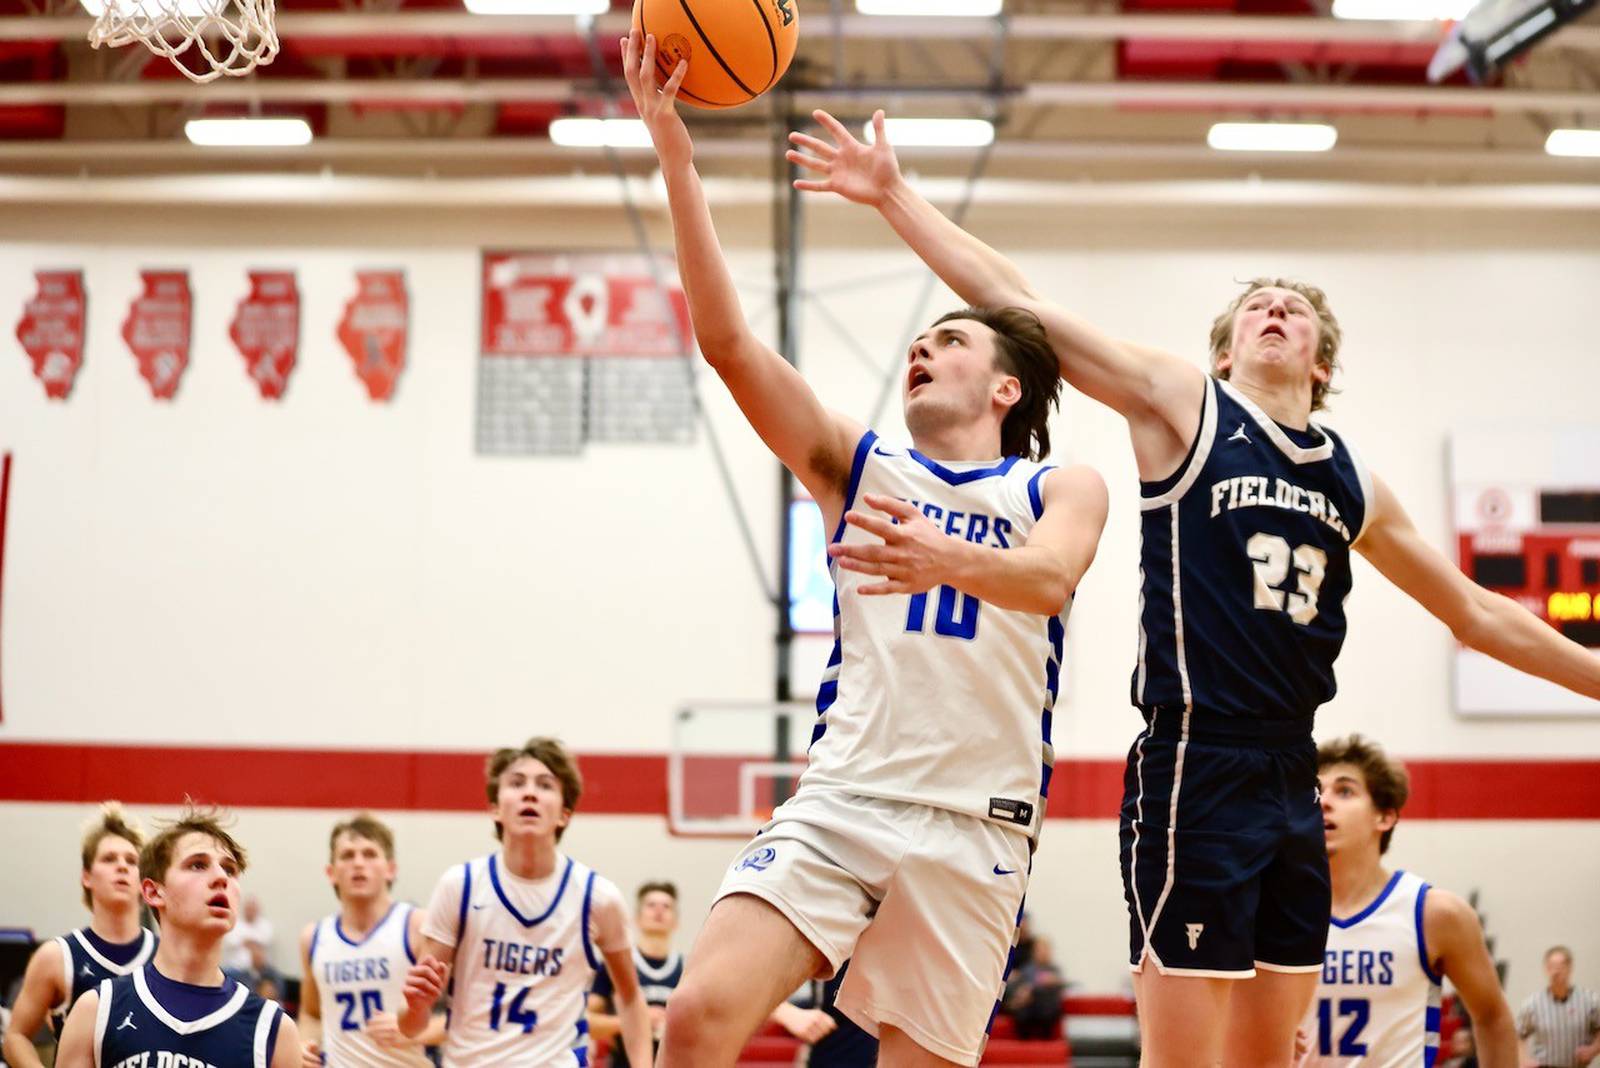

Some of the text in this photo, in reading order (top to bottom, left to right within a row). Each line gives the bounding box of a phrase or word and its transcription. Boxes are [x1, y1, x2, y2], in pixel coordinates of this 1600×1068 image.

[1246, 531, 1328, 626] 23
[904, 584, 981, 640] 10
[324, 957, 390, 984] TIGERS
[483, 938, 563, 977] TIGERS
[1322, 950, 1394, 985] GERS
[334, 990, 384, 1031] 20
[489, 981, 538, 1034] 14
[1317, 998, 1371, 1057] 12
